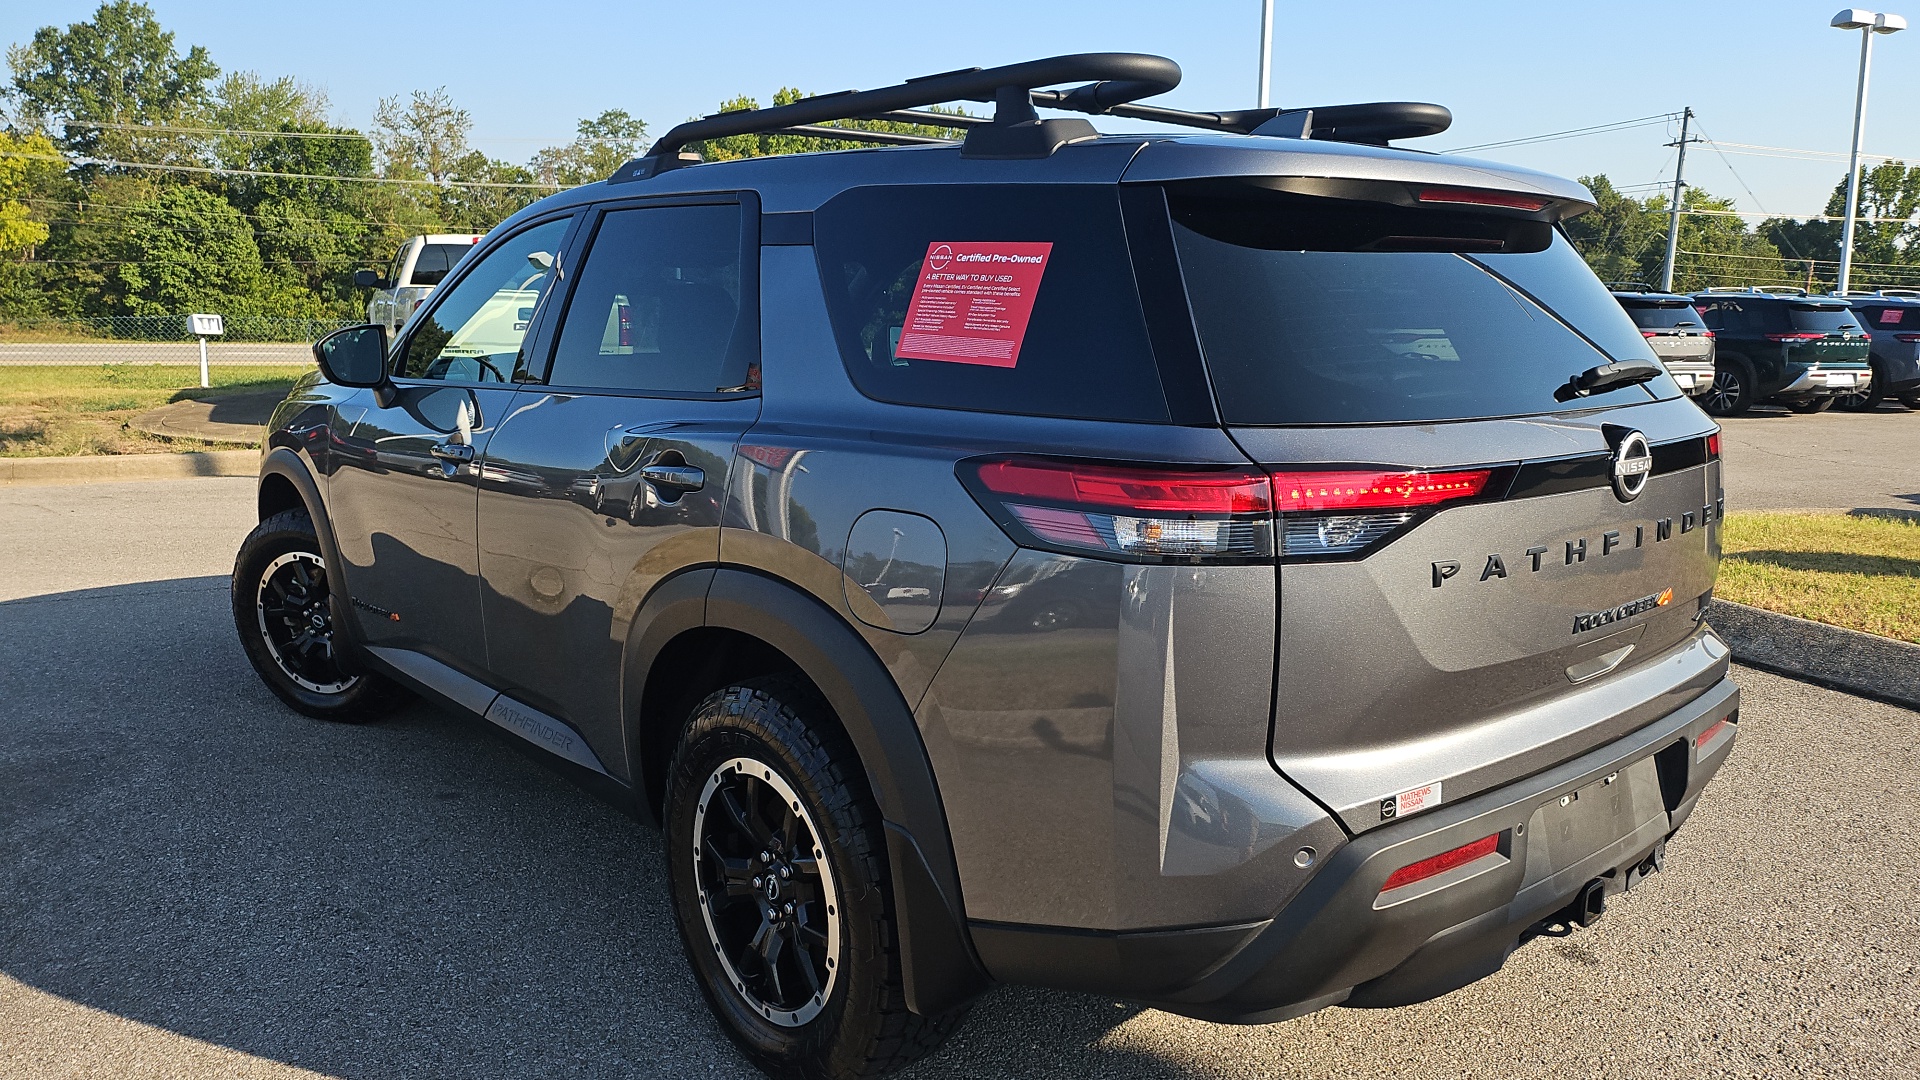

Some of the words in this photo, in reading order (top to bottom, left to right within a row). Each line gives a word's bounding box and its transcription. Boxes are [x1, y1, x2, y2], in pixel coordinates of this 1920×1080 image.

[956, 253, 991, 263] Certified
[992, 254, 1043, 263] Pre-Owned
[931, 273, 955, 281] BETTER
[970, 274, 980, 282] TO
[994, 275, 1013, 283] USED
[1431, 497, 1724, 589] PATHFINDER
[492, 702, 574, 752] PATHFINDER
[1400, 786, 1431, 802] MATHEWS
[1400, 797, 1423, 810] NISSAN
